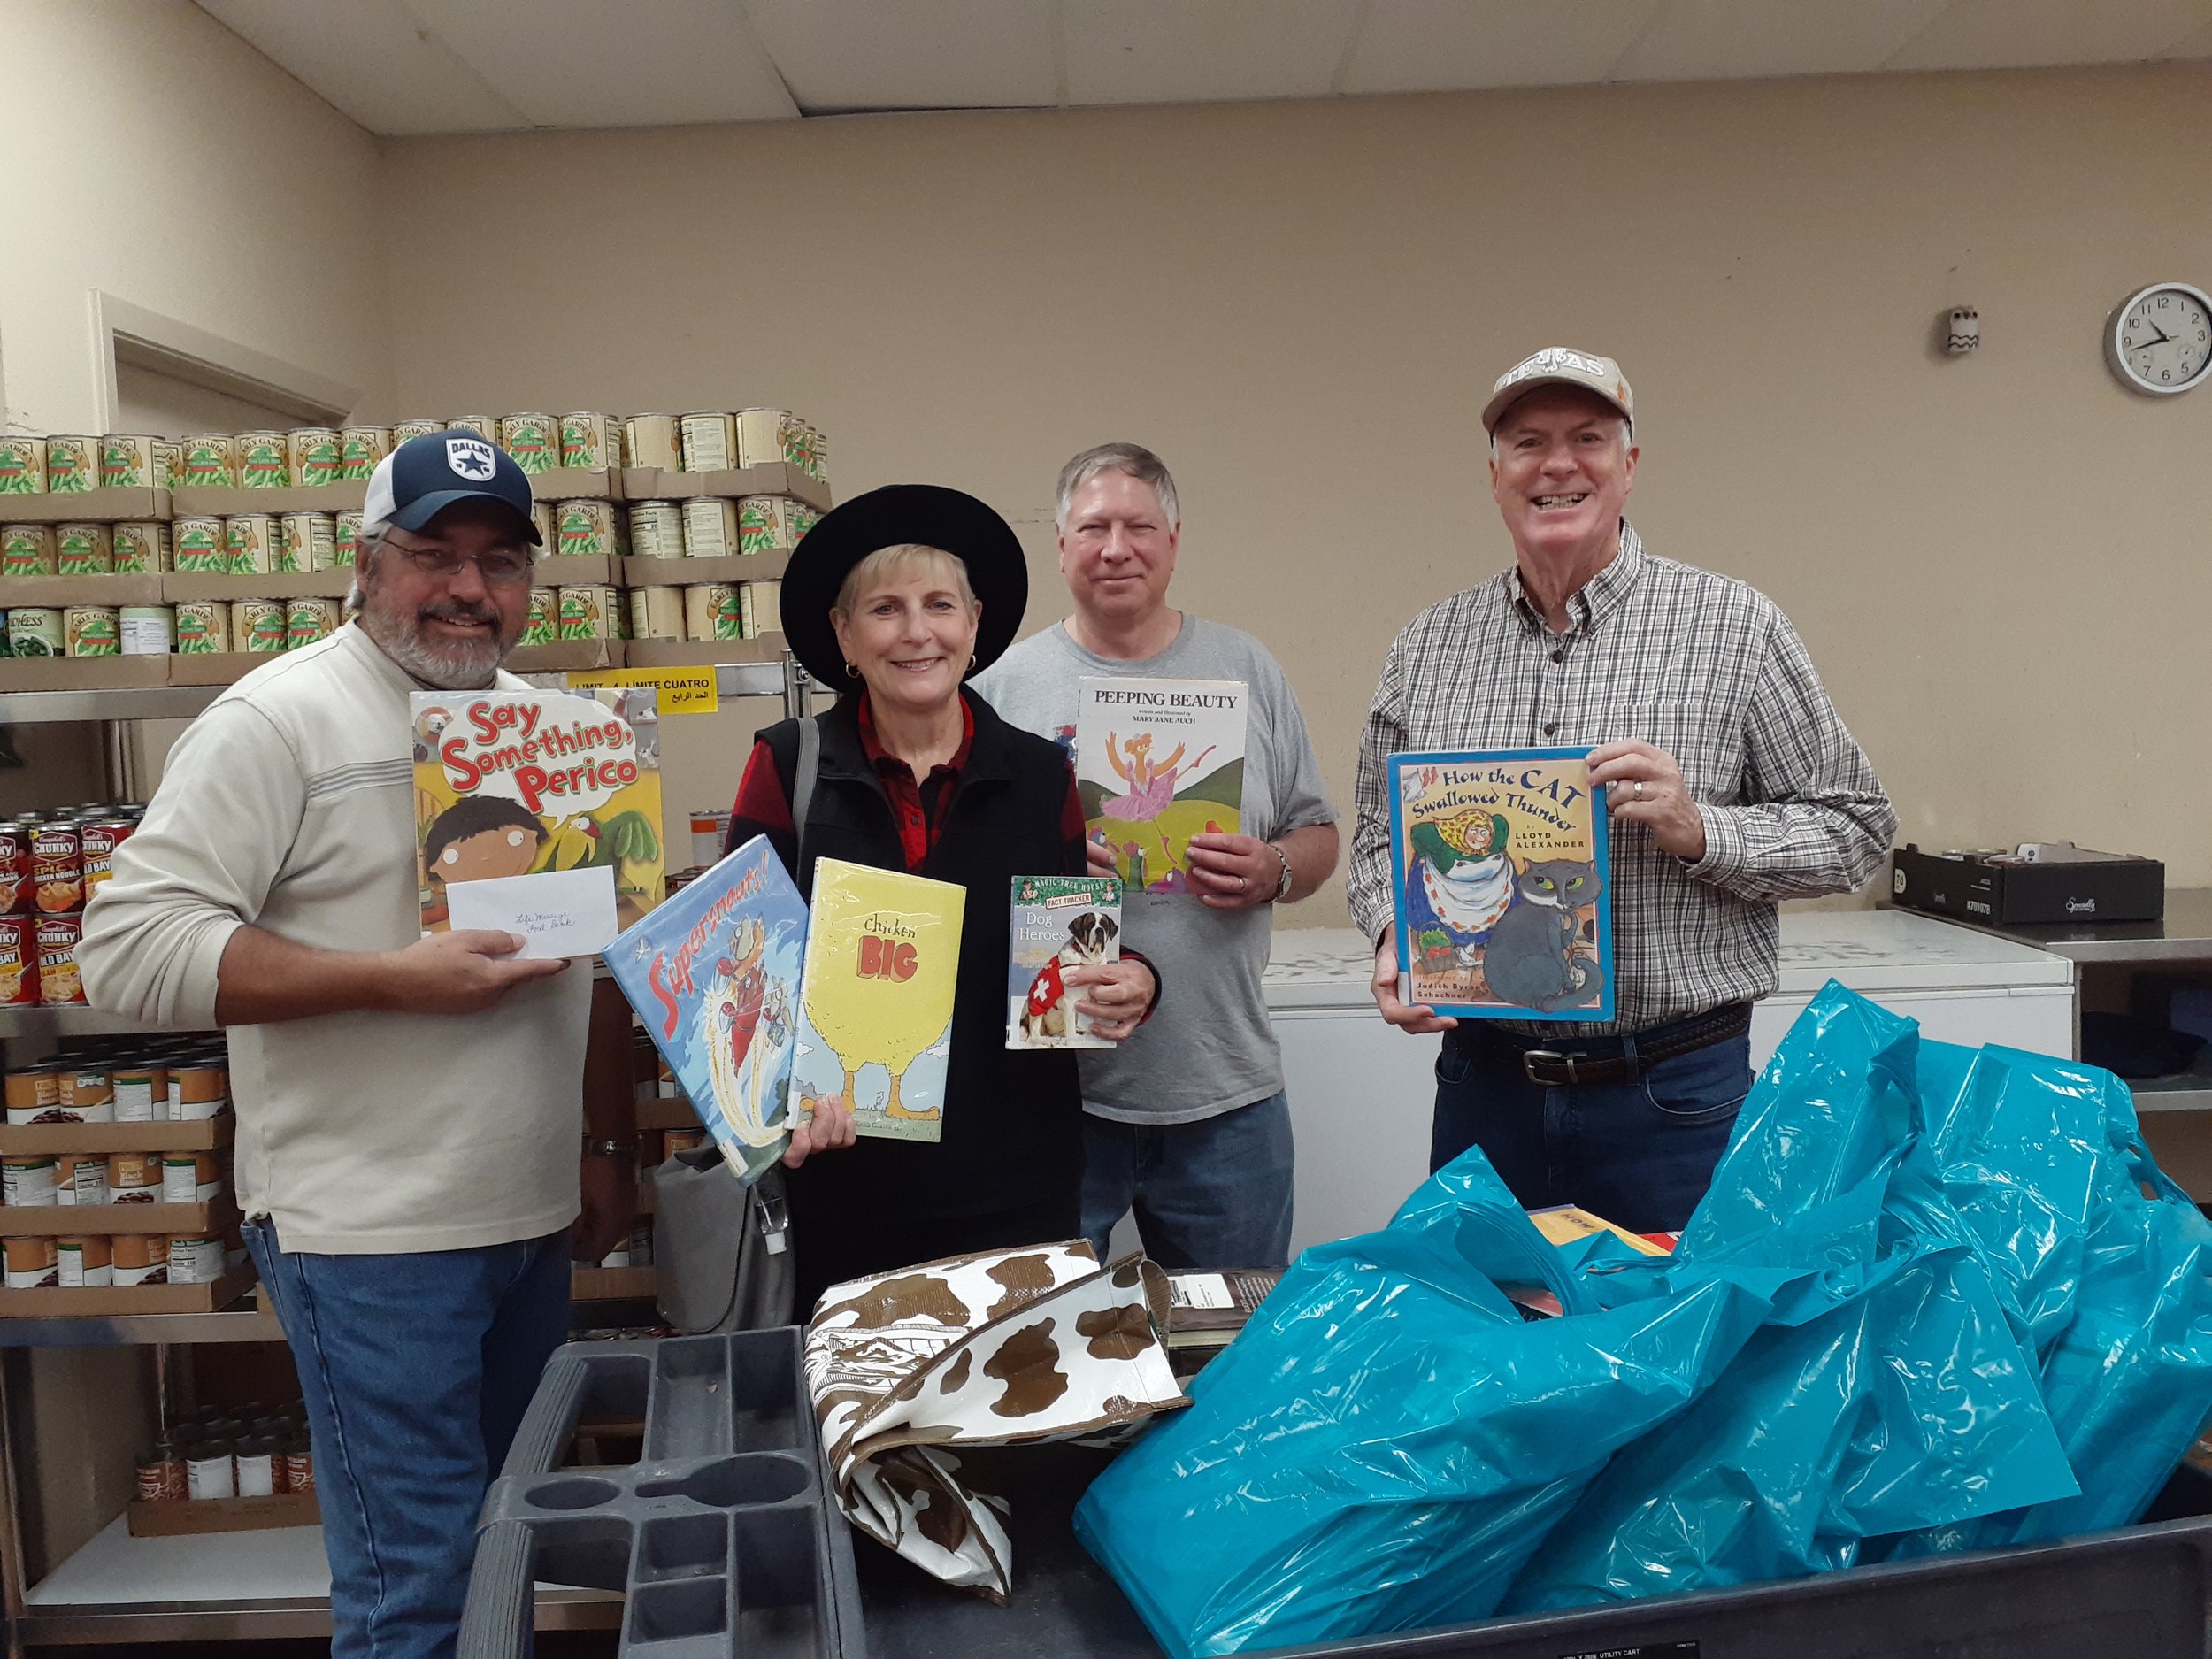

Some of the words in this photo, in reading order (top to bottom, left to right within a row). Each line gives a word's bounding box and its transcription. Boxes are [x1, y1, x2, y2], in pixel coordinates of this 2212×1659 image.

[2141, 303, 2151, 315] 11
[2157, 296, 2170, 310] 12
[2128, 318, 2140, 329] 10
[2191, 312, 2200, 325] 2
[2124, 336, 2131, 347] 9
[2197, 329, 2206, 342] 3
[2143, 365, 2151, 377] 7
[2181, 362, 2189, 373] 5
[2162, 369, 2170, 380] 6
[451, 442, 491, 459] DALLAS
[664, 679, 710, 690] CUATRO
[1094, 690, 1165, 706] PEEPING
[1170, 694, 1238, 709] BEAUTY
[466, 701, 541, 745] Say
[440, 720, 632, 792] Something,
[511, 757, 638, 816] Perico
[1442, 770, 1484, 787] How
[1488, 768, 1515, 785] the
[1520, 769, 1587, 809] CAT
[1412, 787, 1501, 819] Swallowed
[1505, 793, 1577, 832] Thunder
[34, 841, 74, 855] CHUNKY
[94, 860, 111, 872] BAY
[55, 869, 81, 879] NOODLE
[1061, 879, 1078, 890] TREE
[1081, 882, 1105, 892] HOUSE
[1048, 898, 1062, 907] FACT
[1064, 895, 1090, 905] TRACKER
[864, 913, 916, 938] Chicken
[1026, 912, 1053, 928] Dog
[37, 931, 76, 942] CHUNKY
[1019, 927, 1065, 941] Heroes
[648, 849, 769, 1042] Supersnouts!
[856, 934, 918, 984] BIG
